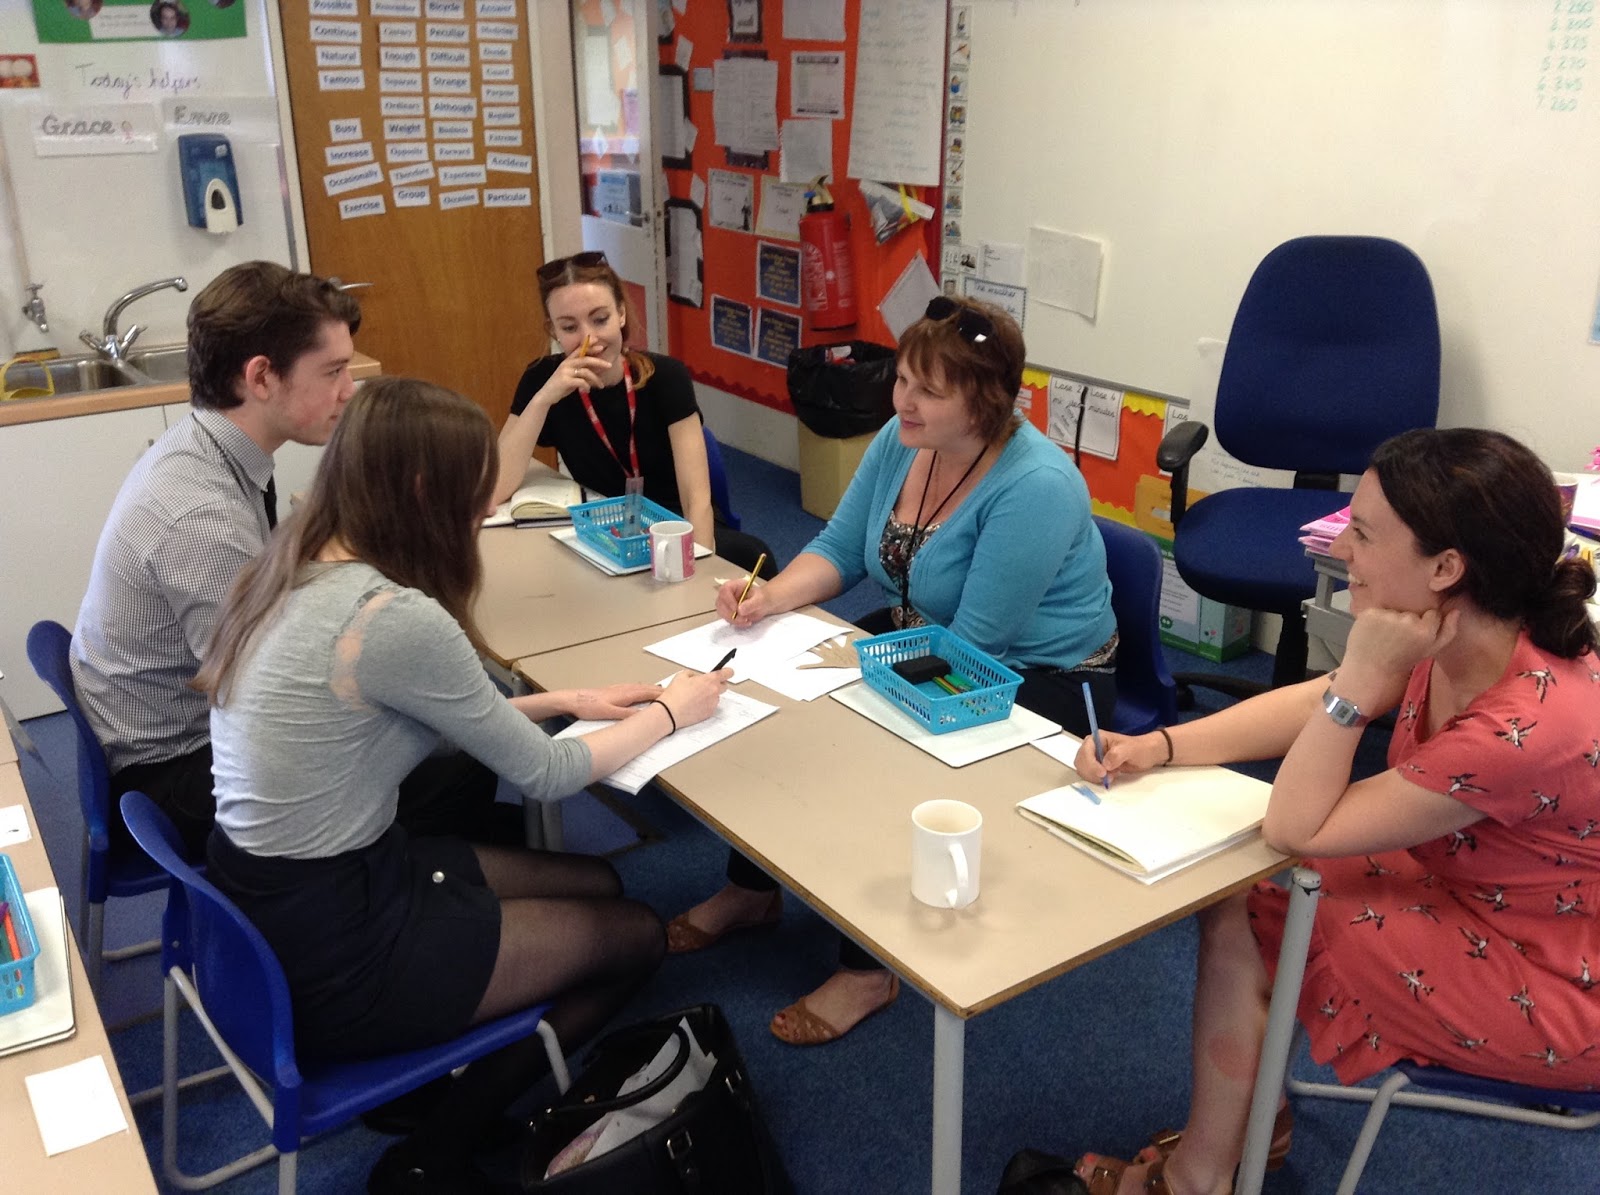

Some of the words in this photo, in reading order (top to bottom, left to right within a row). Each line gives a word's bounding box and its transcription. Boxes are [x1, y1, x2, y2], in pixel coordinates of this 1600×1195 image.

[315, 26, 358, 37] Continue
[430, 28, 465, 38] Peculiar
[321, 52, 356, 61] Natural
[385, 52, 415, 63] Enough
[431, 53, 465, 62] Difficult
[324, 75, 360, 84] Famous
[433, 77, 467, 87] Strange
[434, 103, 473, 113] Although
[41, 114, 116, 136] Grace
[335, 124, 356, 134] Busy
[390, 124, 420, 134] Weight
[331, 149, 368, 159] Increase
[492, 157, 528, 168] Accident
[329, 170, 378, 187] Occasionally
[398, 191, 425, 200] Group
[487, 193, 527, 202] Particular
[344, 200, 380, 213] Exercise
[1054, 380, 1073, 392] Lose
[1076, 384, 1082, 394] 2
[1090, 387, 1107, 399] Lose
[1172, 409, 1188, 421] Los
